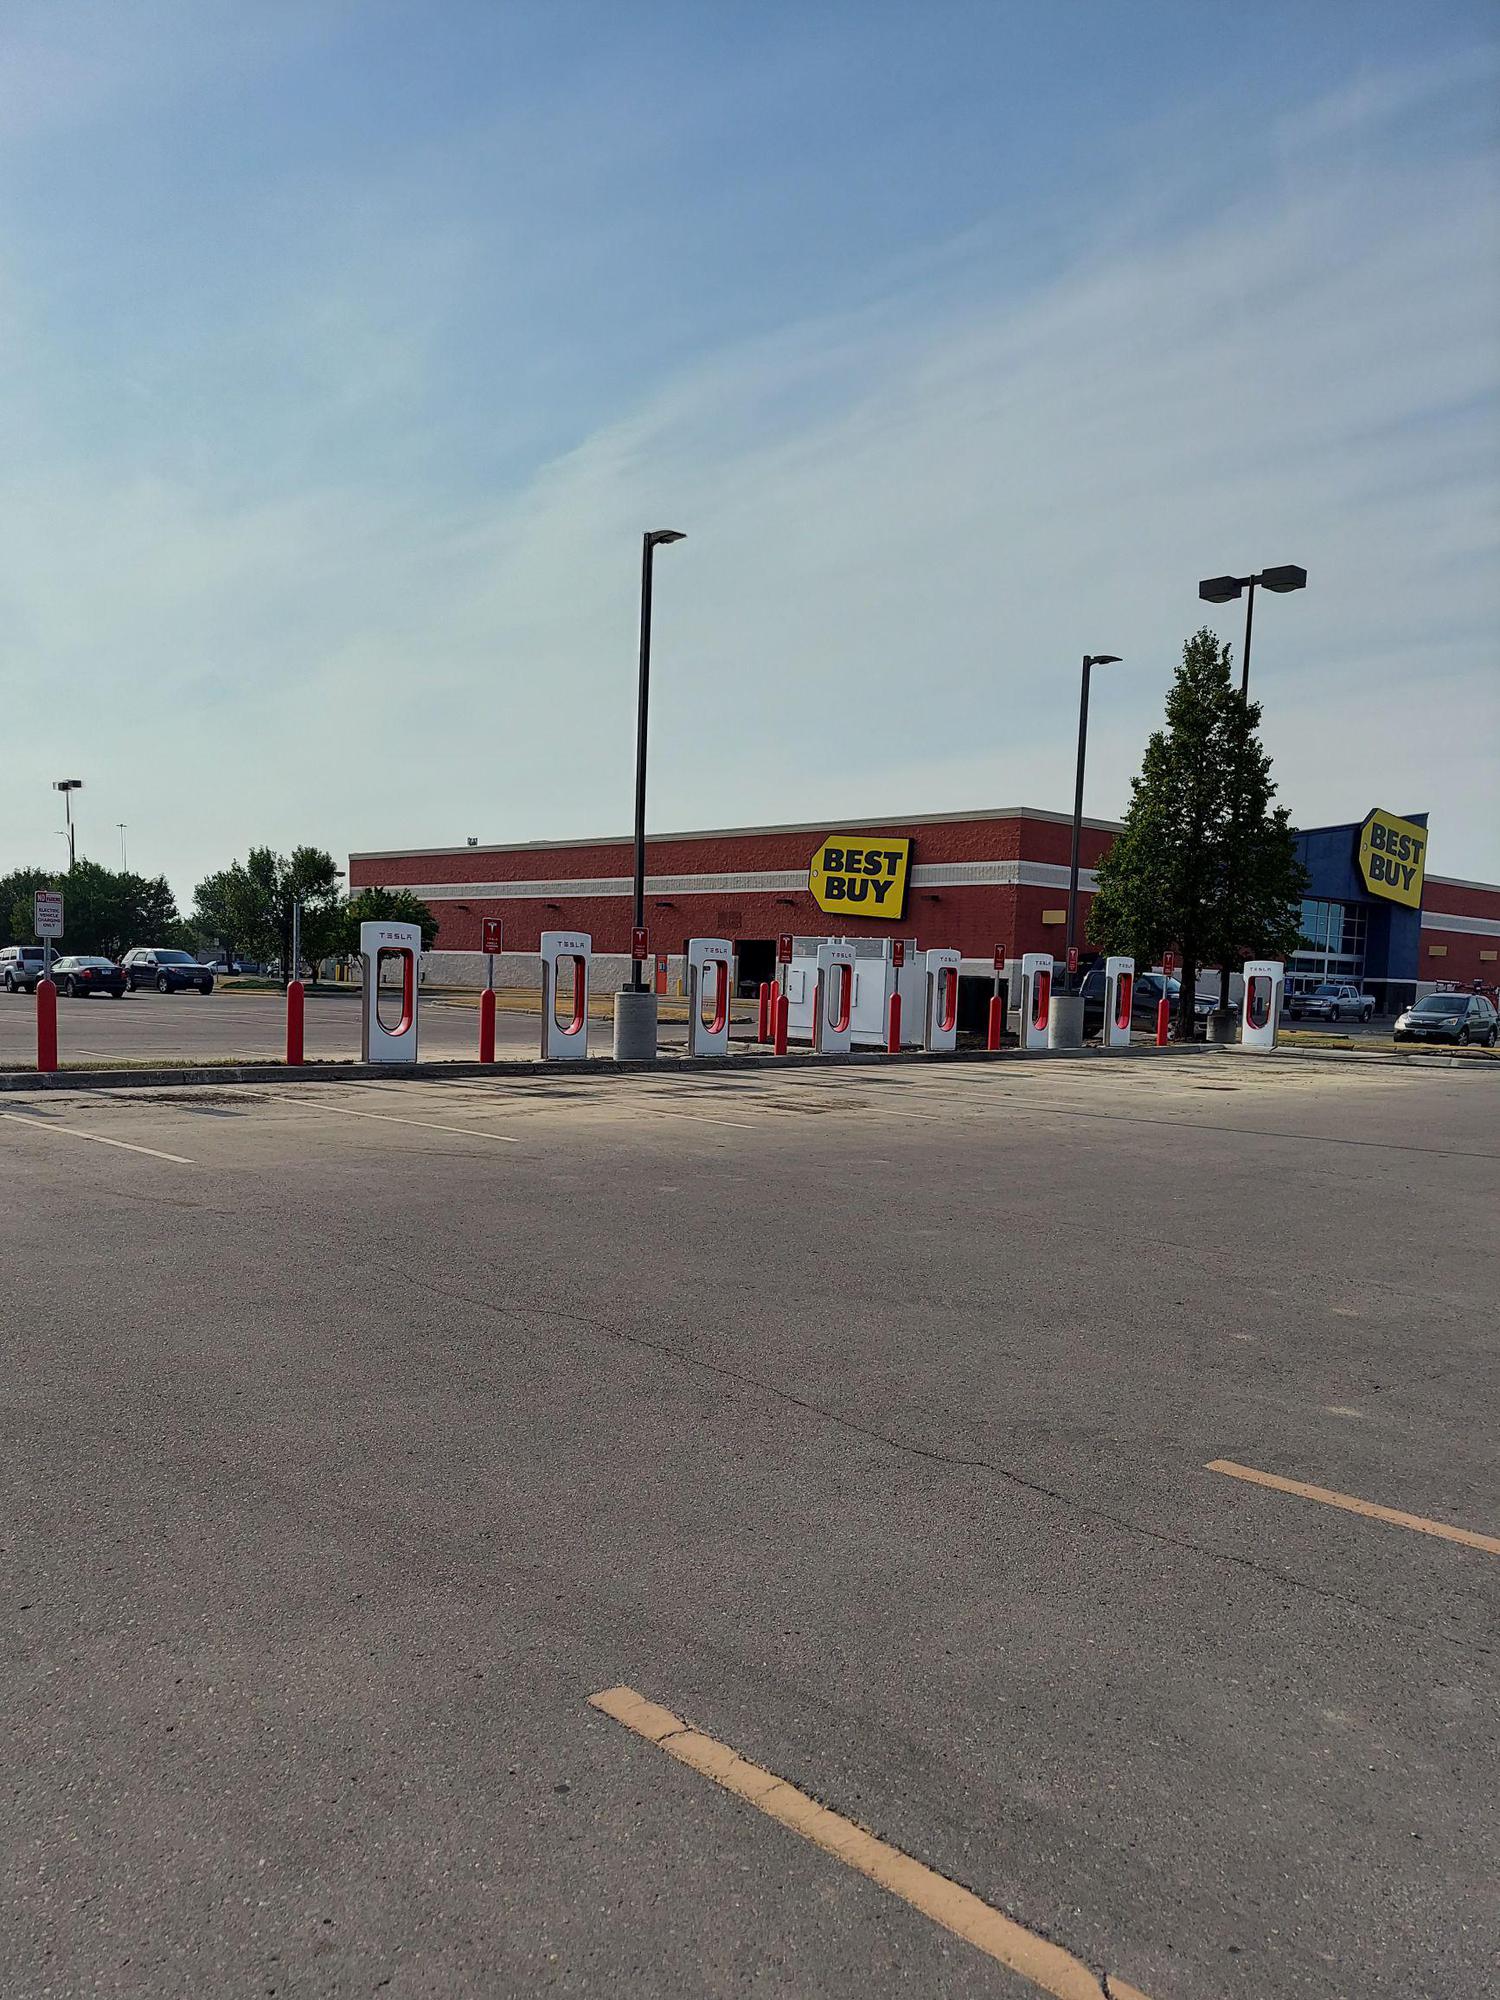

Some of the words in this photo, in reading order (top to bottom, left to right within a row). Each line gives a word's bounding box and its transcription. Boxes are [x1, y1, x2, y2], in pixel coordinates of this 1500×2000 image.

[1370, 822, 1423, 864] BEST
[822, 848, 903, 876] BEST
[1369, 853, 1416, 891] BUY
[824, 876, 894, 904] BUY
[379, 932, 412, 940] TESLA
